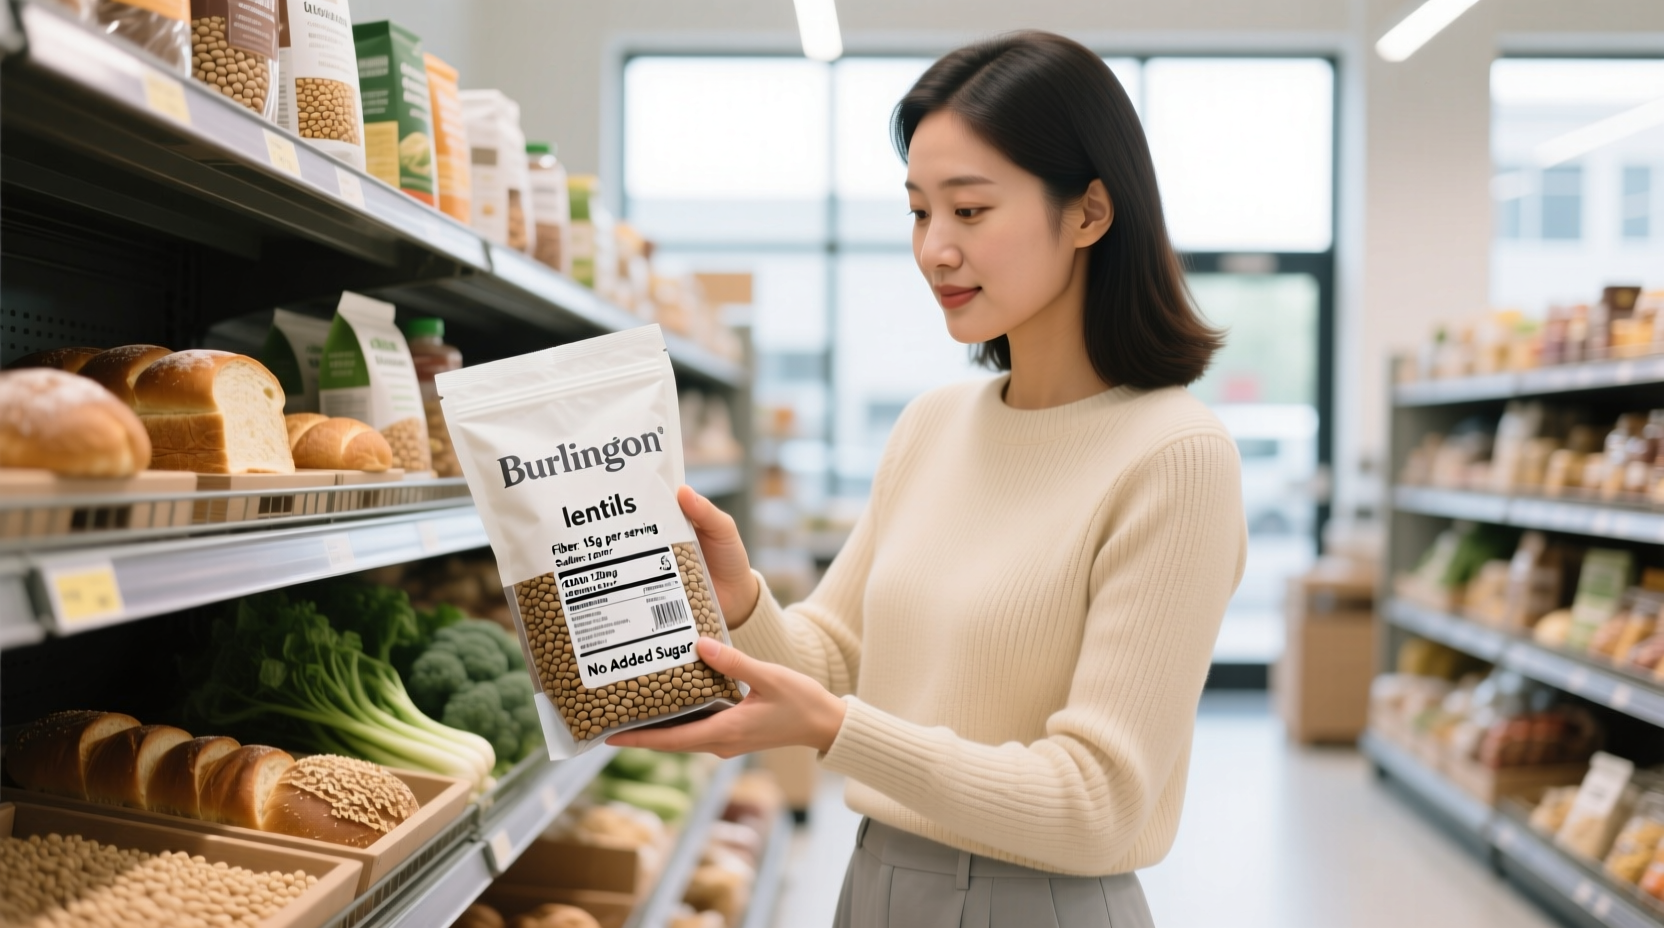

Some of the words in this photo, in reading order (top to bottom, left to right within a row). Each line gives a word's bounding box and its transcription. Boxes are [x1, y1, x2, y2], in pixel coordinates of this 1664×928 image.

[562, 493, 637, 528] lentils
[583, 535, 603, 548] 15g
[605, 532, 622, 547] per
[624, 522, 659, 539] serving
[587, 661, 607, 677] No
[610, 648, 653, 672] Added
[655, 641, 694, 660] Sugar
